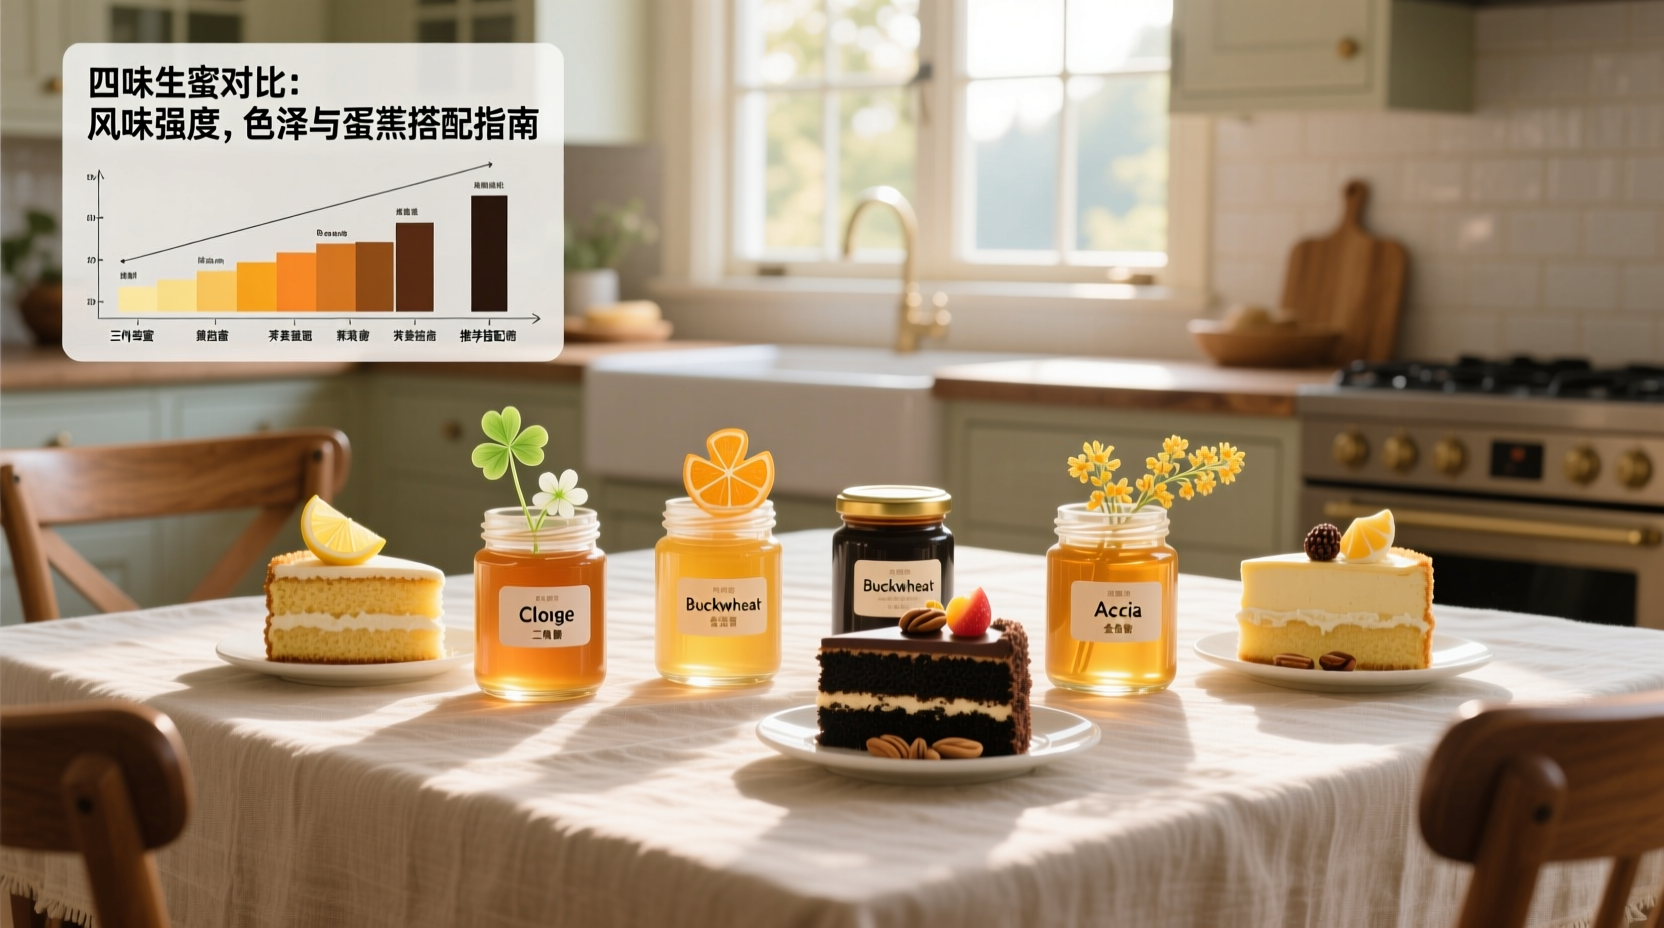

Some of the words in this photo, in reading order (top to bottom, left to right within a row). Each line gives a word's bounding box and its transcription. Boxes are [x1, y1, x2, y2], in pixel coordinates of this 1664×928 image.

[863, 578, 935, 593] Buckwheat
[686, 596, 762, 612] Buckwheat
[1094, 600, 1142, 618] Accia
